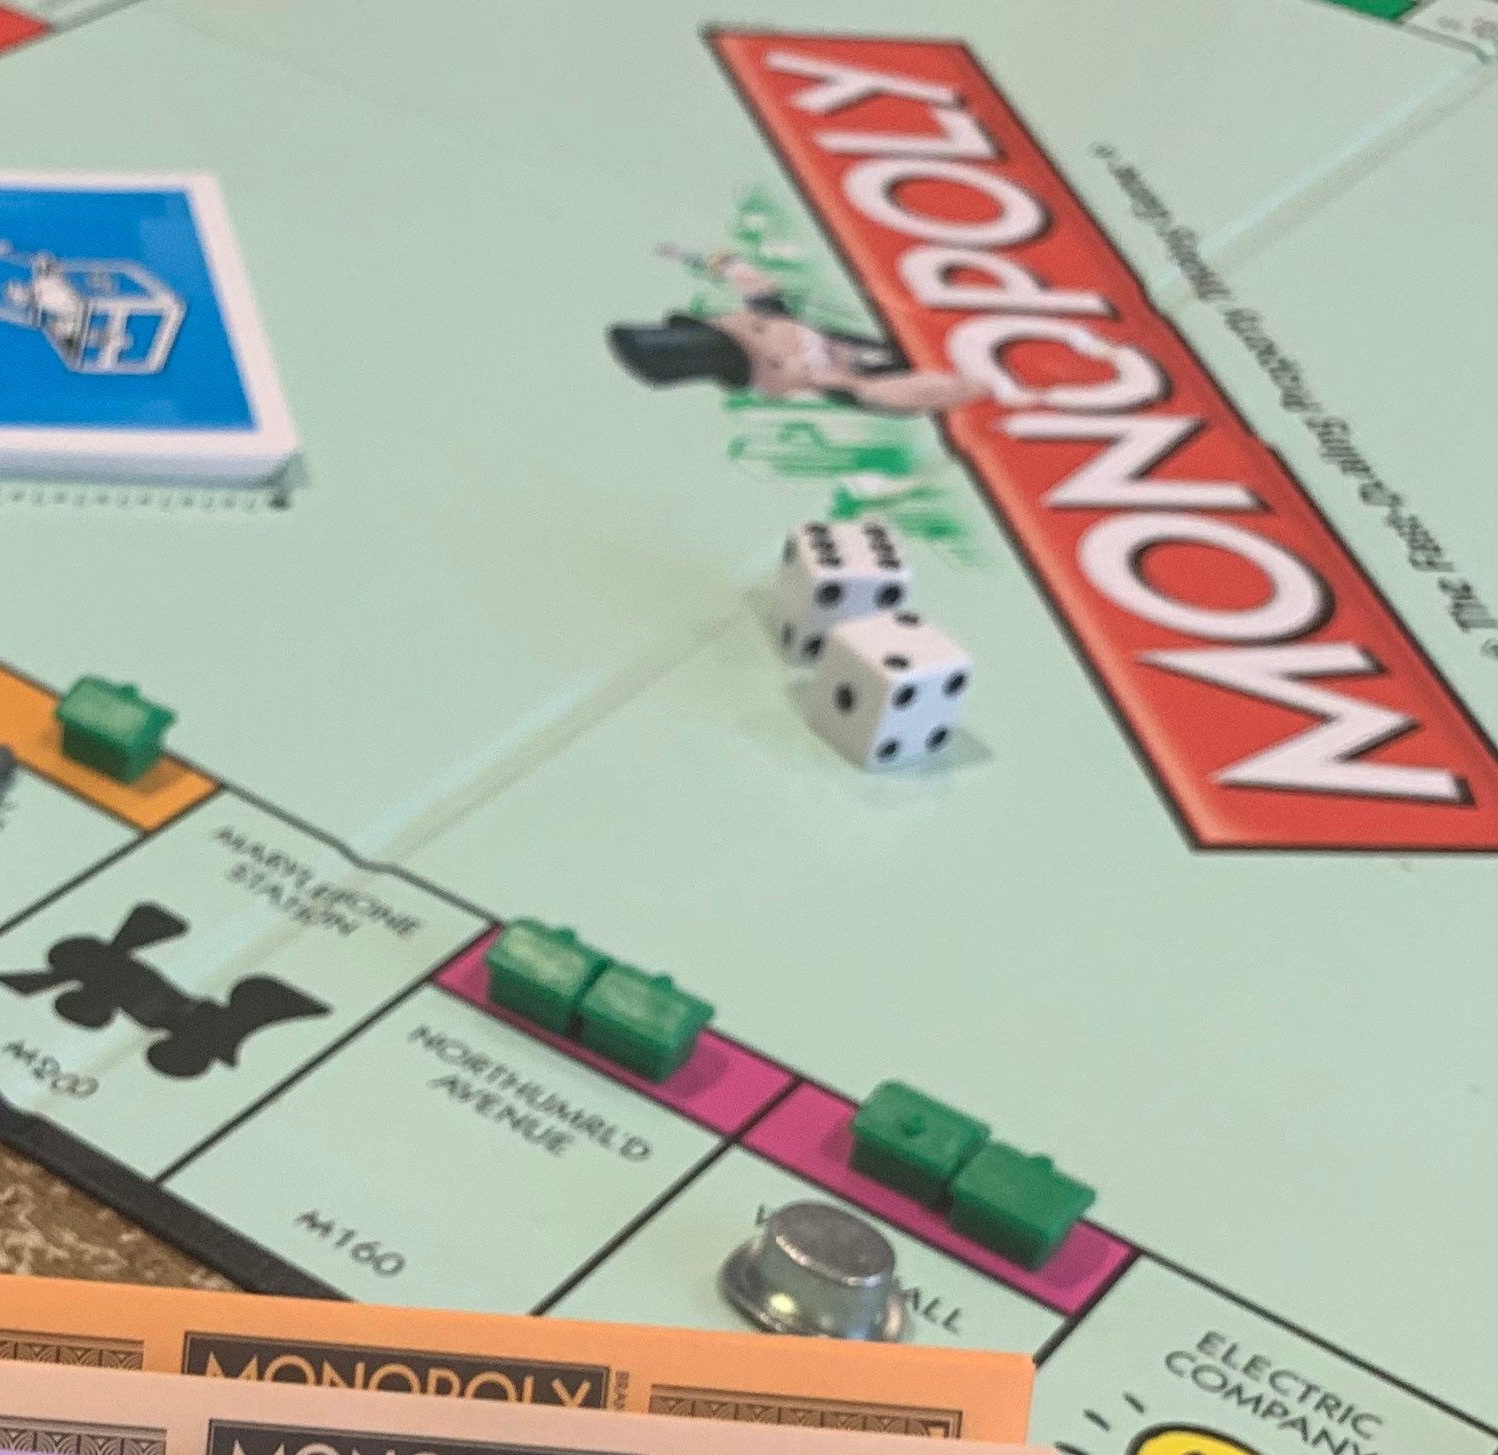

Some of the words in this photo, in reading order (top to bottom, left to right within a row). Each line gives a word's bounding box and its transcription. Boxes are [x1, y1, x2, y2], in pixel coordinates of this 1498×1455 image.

[764, 49, 1476, 807] MONOPOLY
[428, 1073, 578, 1158] AVENUE
[1196, 1330, 1383, 1441] ELECTRIC
